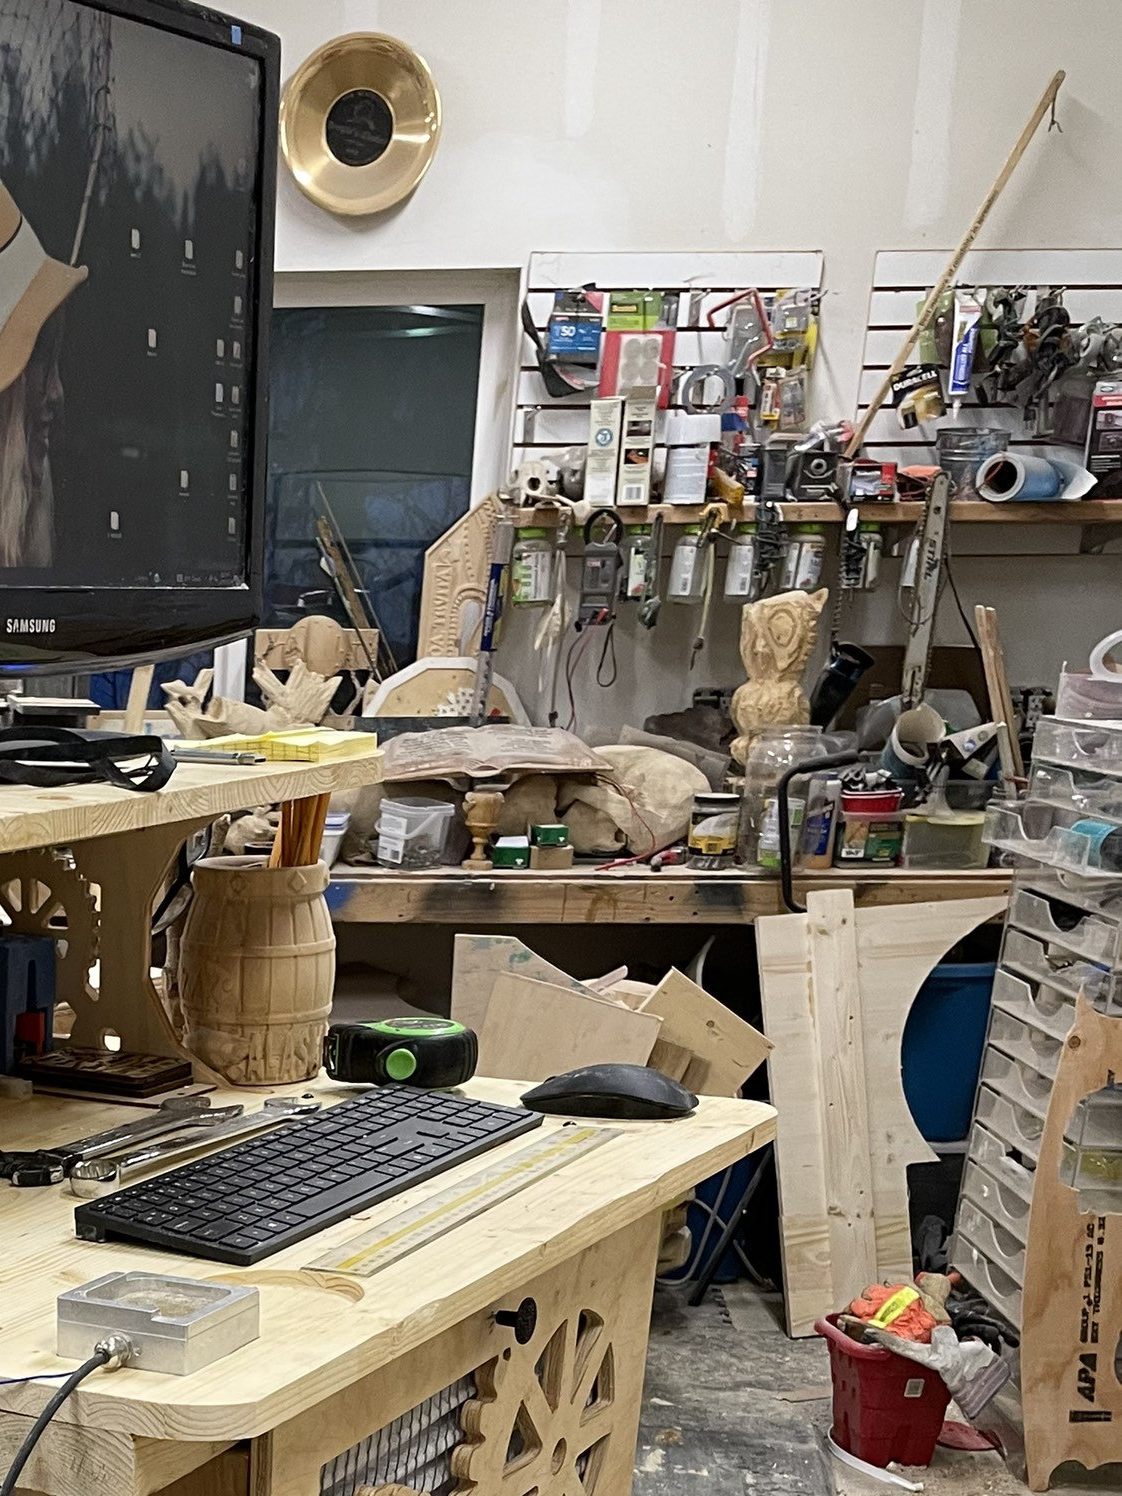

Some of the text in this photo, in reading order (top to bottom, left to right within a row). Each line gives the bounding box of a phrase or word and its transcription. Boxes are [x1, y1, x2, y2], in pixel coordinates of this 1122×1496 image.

[893, 370, 937, 391] DURACELL
[6, 618, 56, 634] SAMSUNG
[1077, 1353, 1097, 1403] APA
